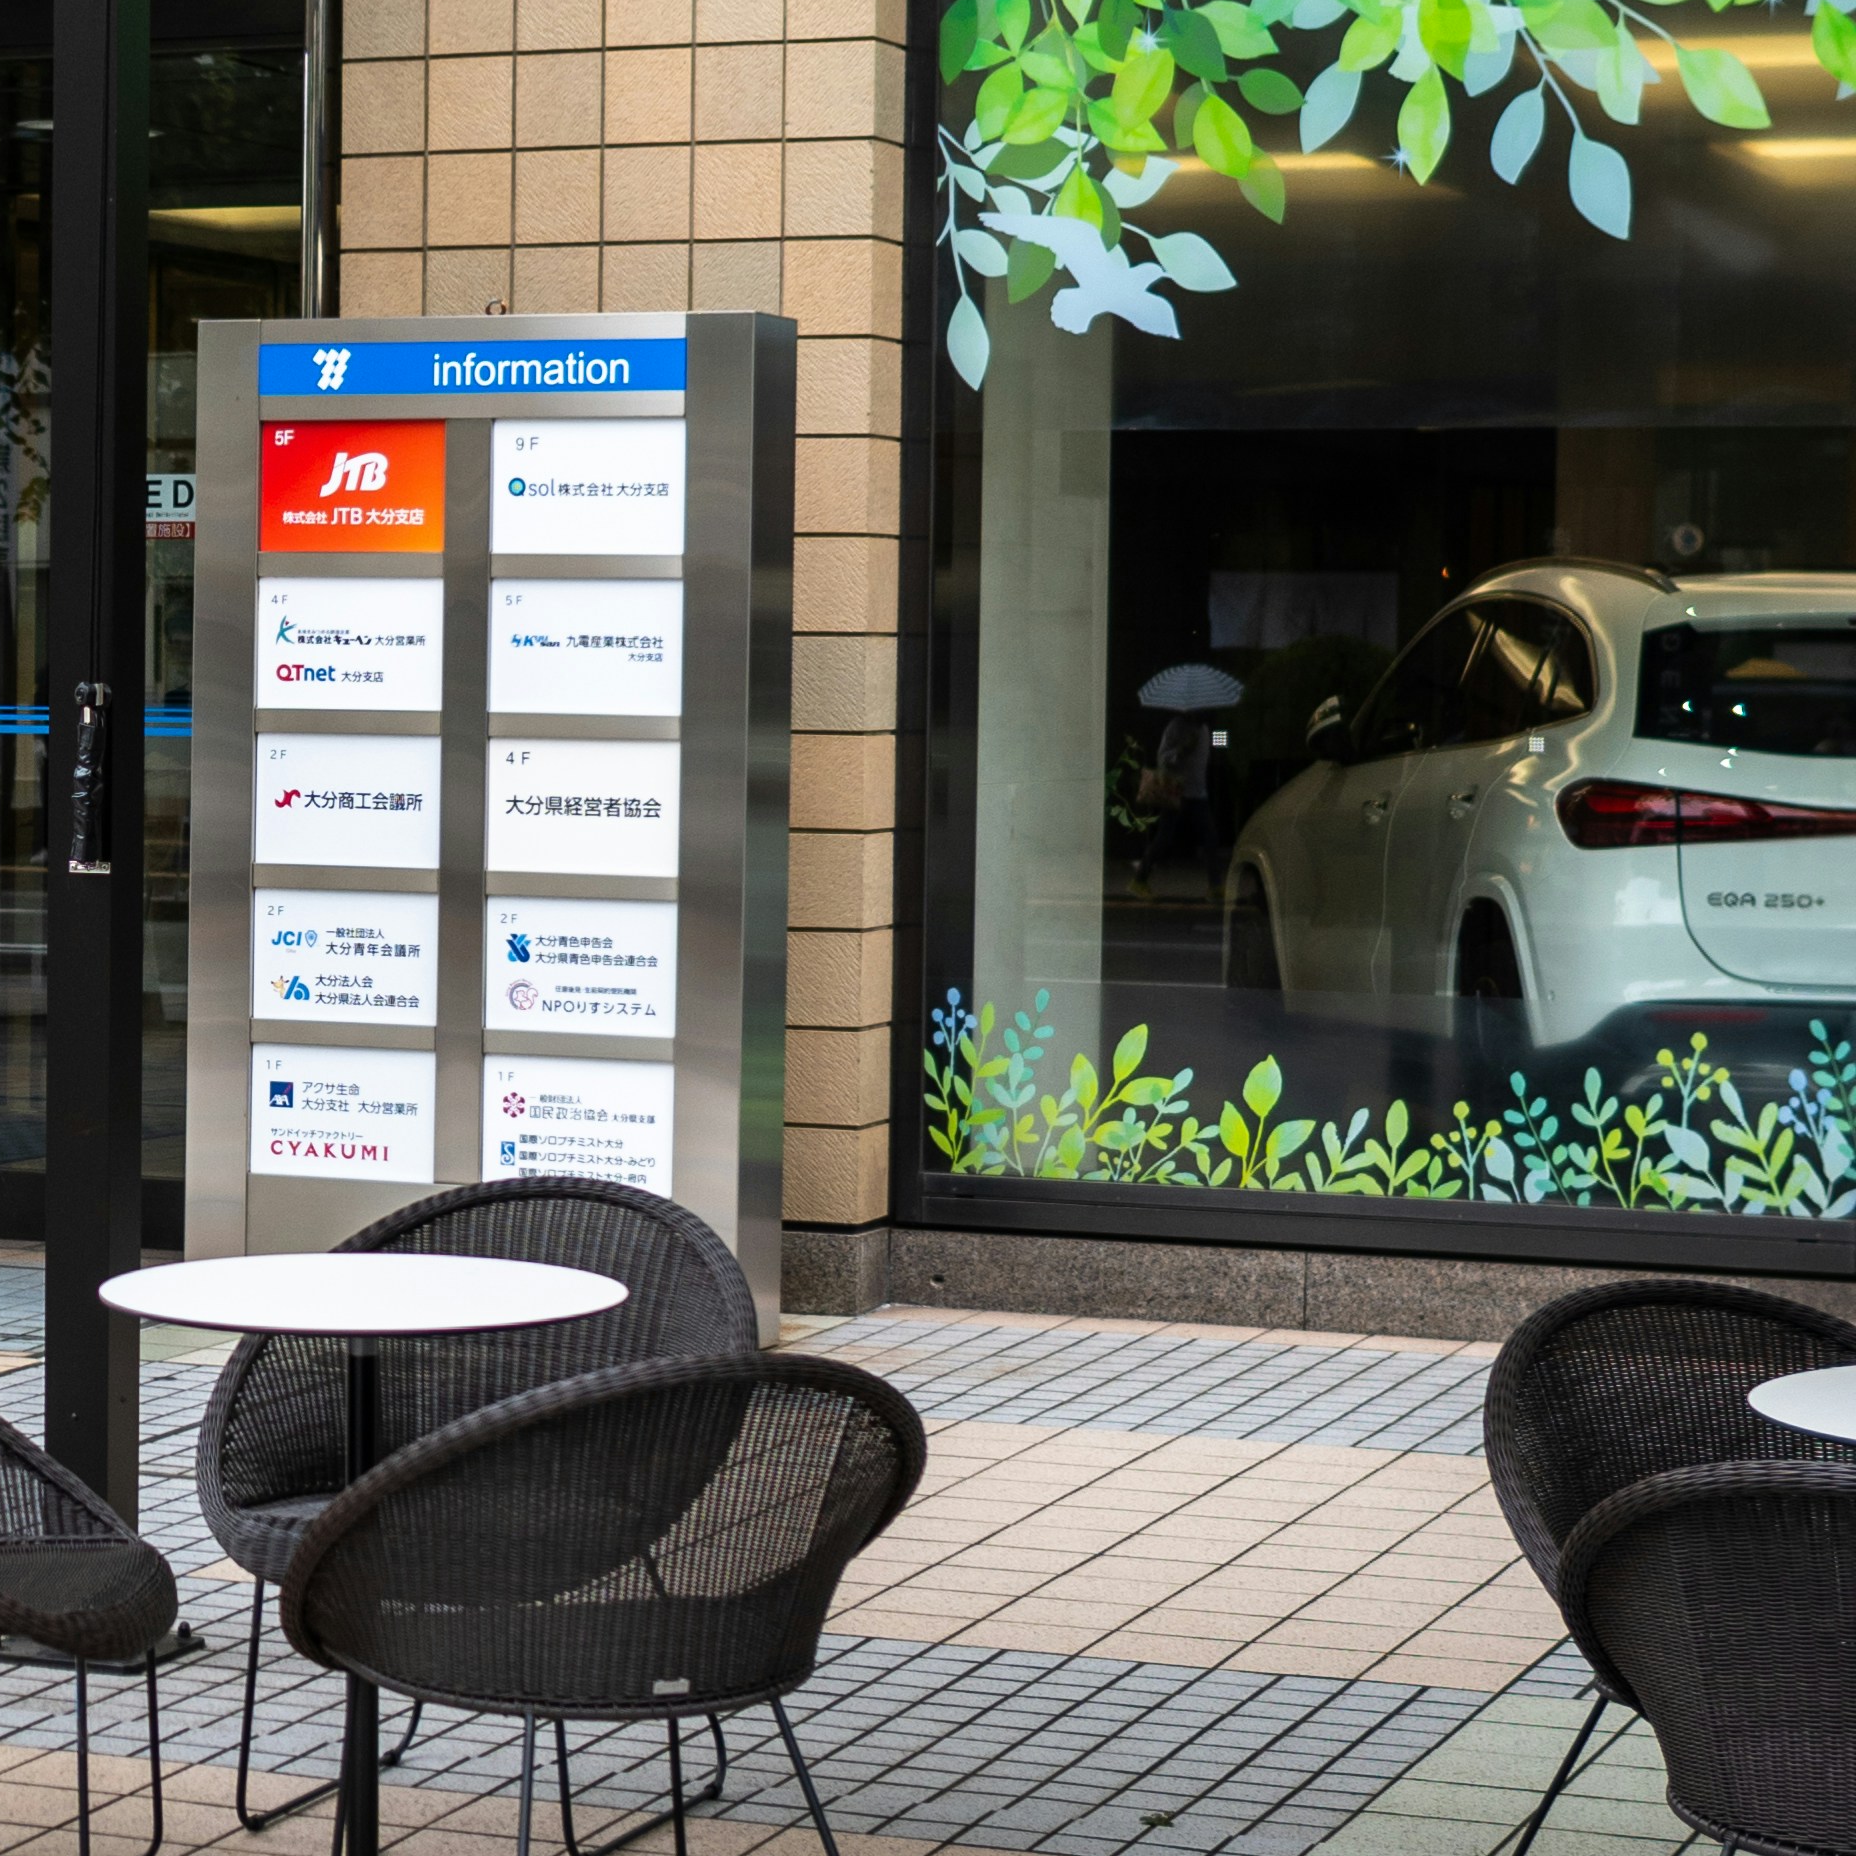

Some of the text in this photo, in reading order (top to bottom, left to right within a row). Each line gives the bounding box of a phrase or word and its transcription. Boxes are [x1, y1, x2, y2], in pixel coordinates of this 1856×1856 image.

[433, 352, 630, 386] information
[274, 429, 295, 446] 5F
[319, 452, 389, 497] JTB
[331, 508, 363, 525] JTB
[366, 508, 424, 525] 大分支店
[374, 636, 426, 647] 大分営業所
[566, 635, 664, 649] 九電産業株式会社
[628, 652, 663, 663] 大分支店
[276, 664, 384, 683] QTnet 大分支店
[304, 790, 423, 812] 大分商工会議所
[505, 795, 662, 818] 大分県経営者協会
[1707, 892, 1756, 908] EQA
[271, 931, 303, 946] JCI
[325, 927, 385, 940] 一般社団法人
[325, 941, 421, 959] 大分青年会議所
[315, 974, 374, 989] 大分法人会
[314, 993, 420, 1009] 大分県法人会連合会
[541, 999, 657, 1017] NPOりすシステム
[302, 1081, 360, 1096] アクサ生命
[301, 1098, 419, 1116] 大分支社 大分営業所
[529, 1105, 609, 1122] 国民政治協会
[271, 1127, 364, 1141] サンドイッチファクトリー
[270, 1140, 389, 1162] CYAKUMI
